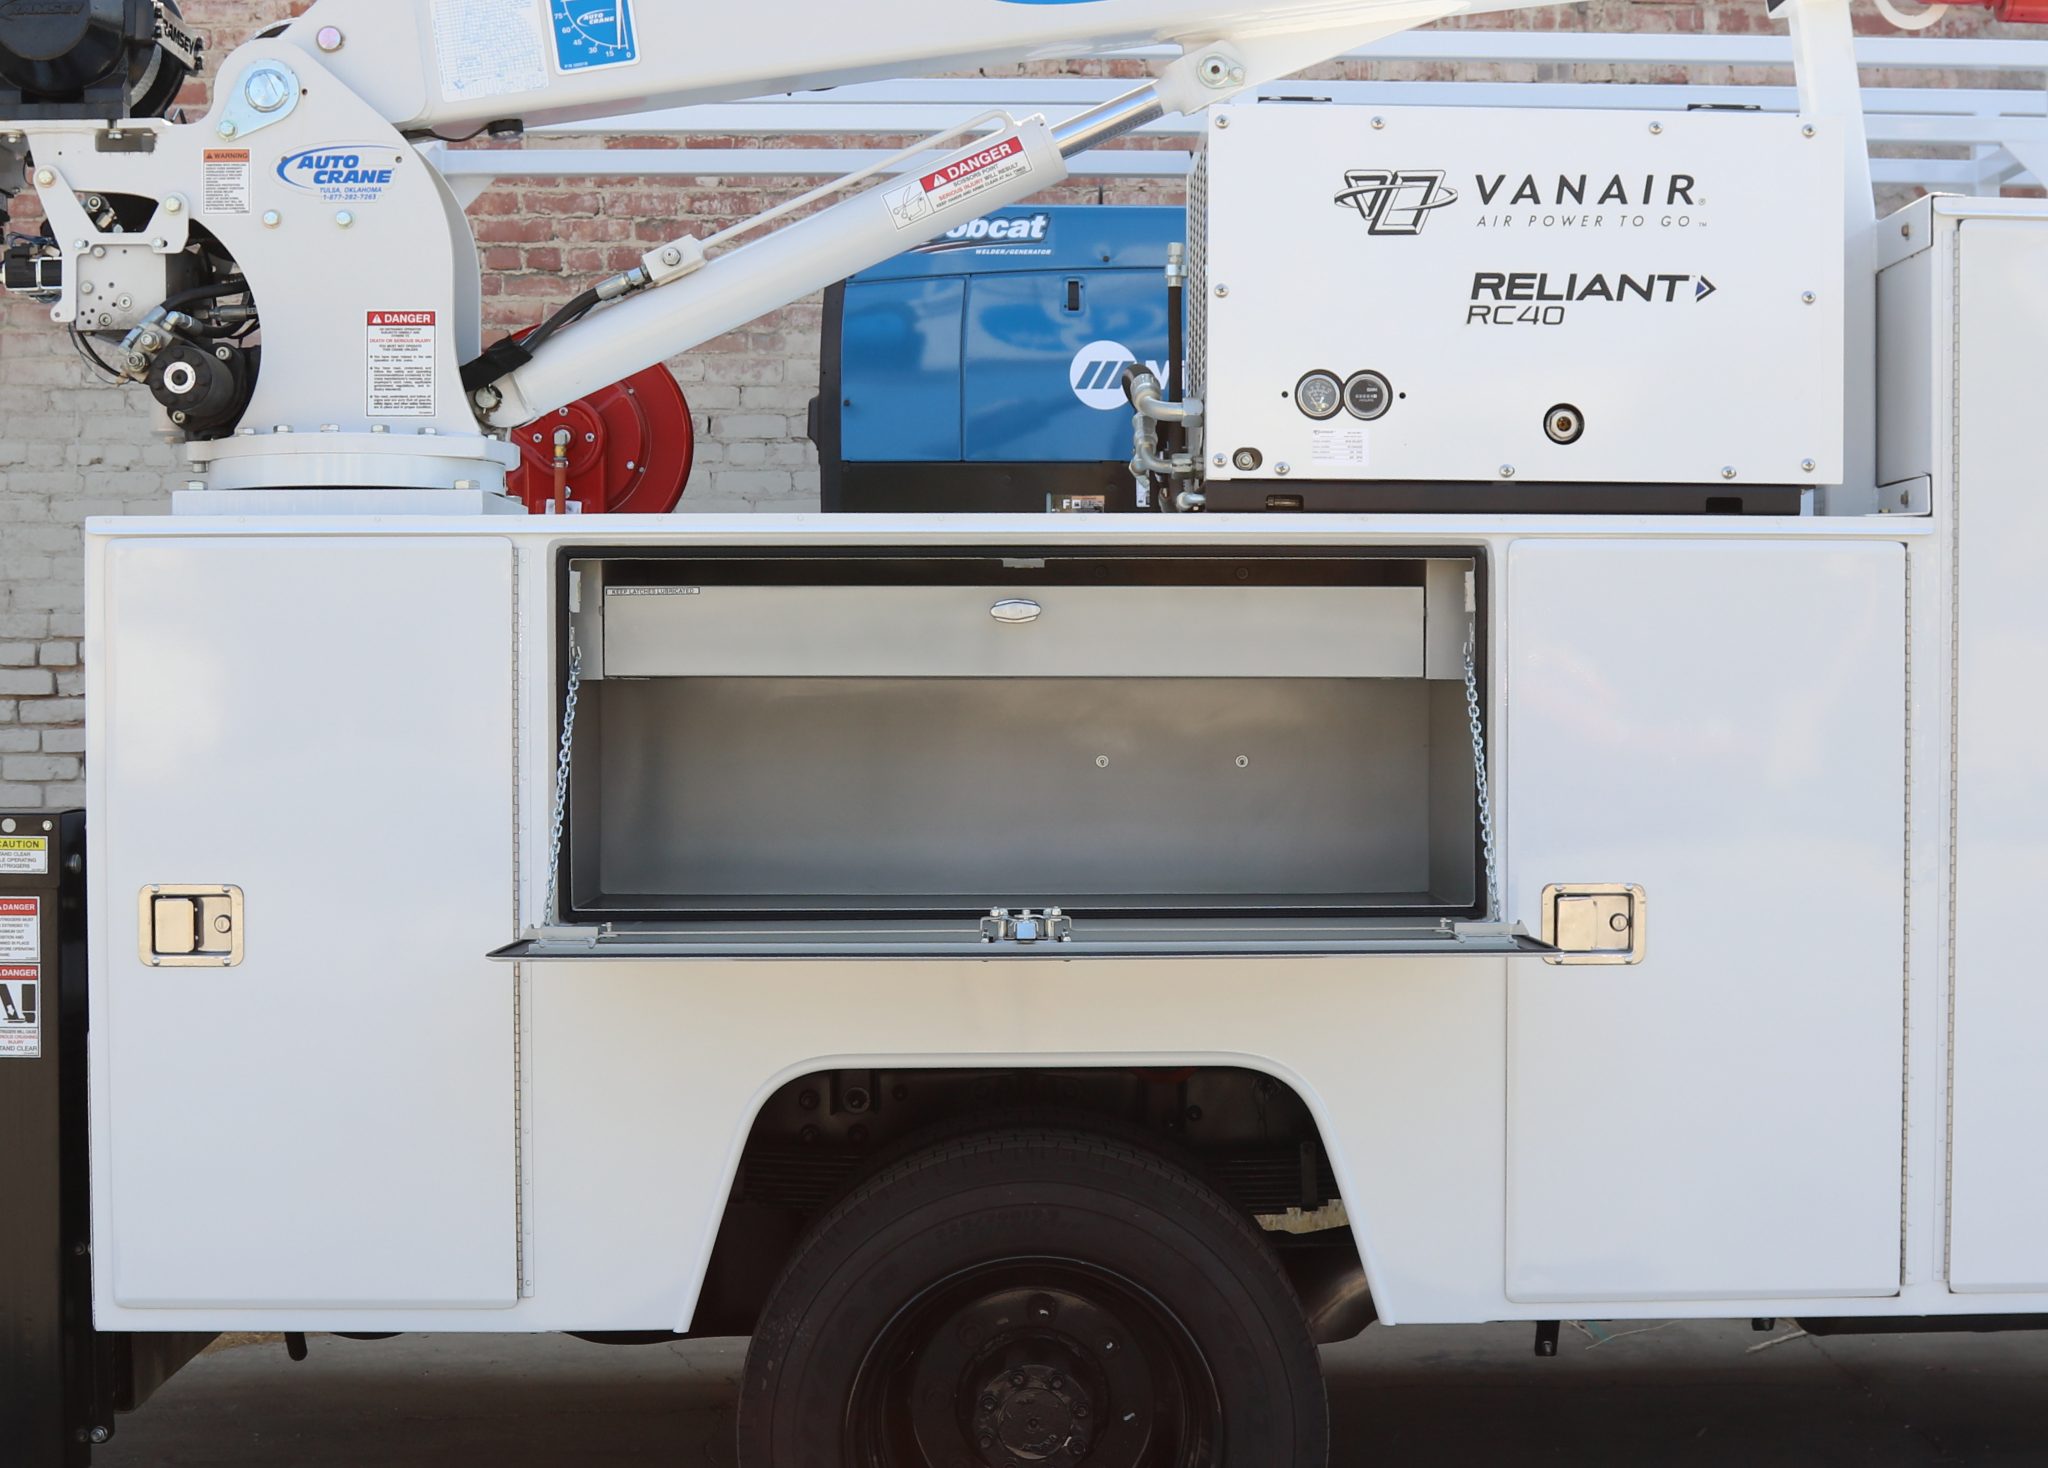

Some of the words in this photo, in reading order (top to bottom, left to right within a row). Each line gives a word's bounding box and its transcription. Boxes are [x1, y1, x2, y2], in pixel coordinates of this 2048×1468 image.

[554, 12, 563, 20] 75
[583, 12, 604, 21] AUTO
[589, 16, 615, 25] CRANE
[162, 18, 195, 55] RAMSEY
[588, 46, 598, 54] 30
[297, 155, 360, 169] AUTO
[946, 143, 1012, 180] DANGER
[313, 170, 393, 185] CRANE
[938, 188, 964, 201] SERIOUS
[984, 171, 998, 180] WILL
[998, 162, 1019, 175] RESULT
[320, 187, 341, 195] TULSA,
[1474, 174, 1695, 206] VANAIR
[1477, 215, 1512, 228] AIR
[1528, 215, 1604, 228] POWER
[1620, 215, 1645, 228] TO
[1661, 215, 1691, 228] GO
[1470, 272, 1690, 303] RELIANT
[384, 314, 431, 323] DANGER
[1466, 305, 1566, 326] RC40
[2, 903, 35, 911] DANGER
[2, 969, 37, 977] DANGER
